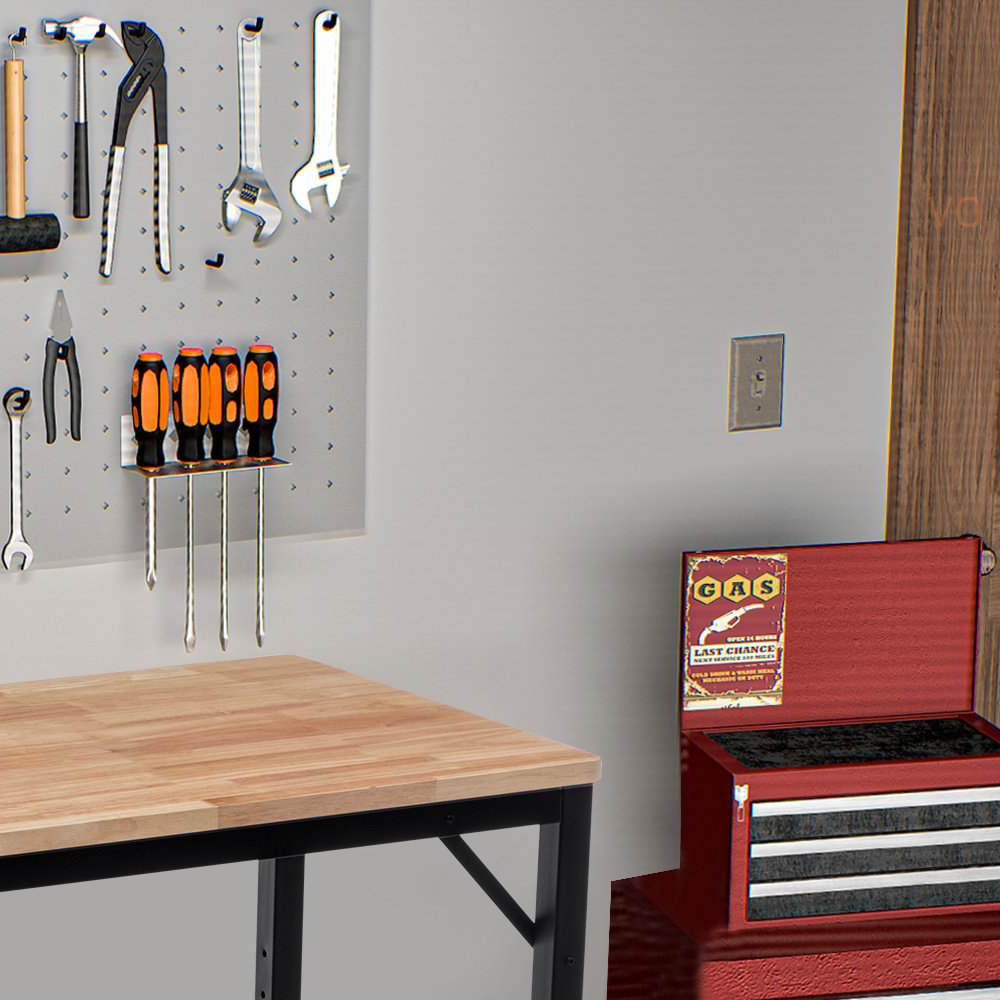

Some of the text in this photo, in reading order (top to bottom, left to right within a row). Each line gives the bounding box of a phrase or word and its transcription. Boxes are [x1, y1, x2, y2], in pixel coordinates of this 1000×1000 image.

[698, 579, 775, 598] GAS
[694, 645, 775, 657] LAST CHANCE
